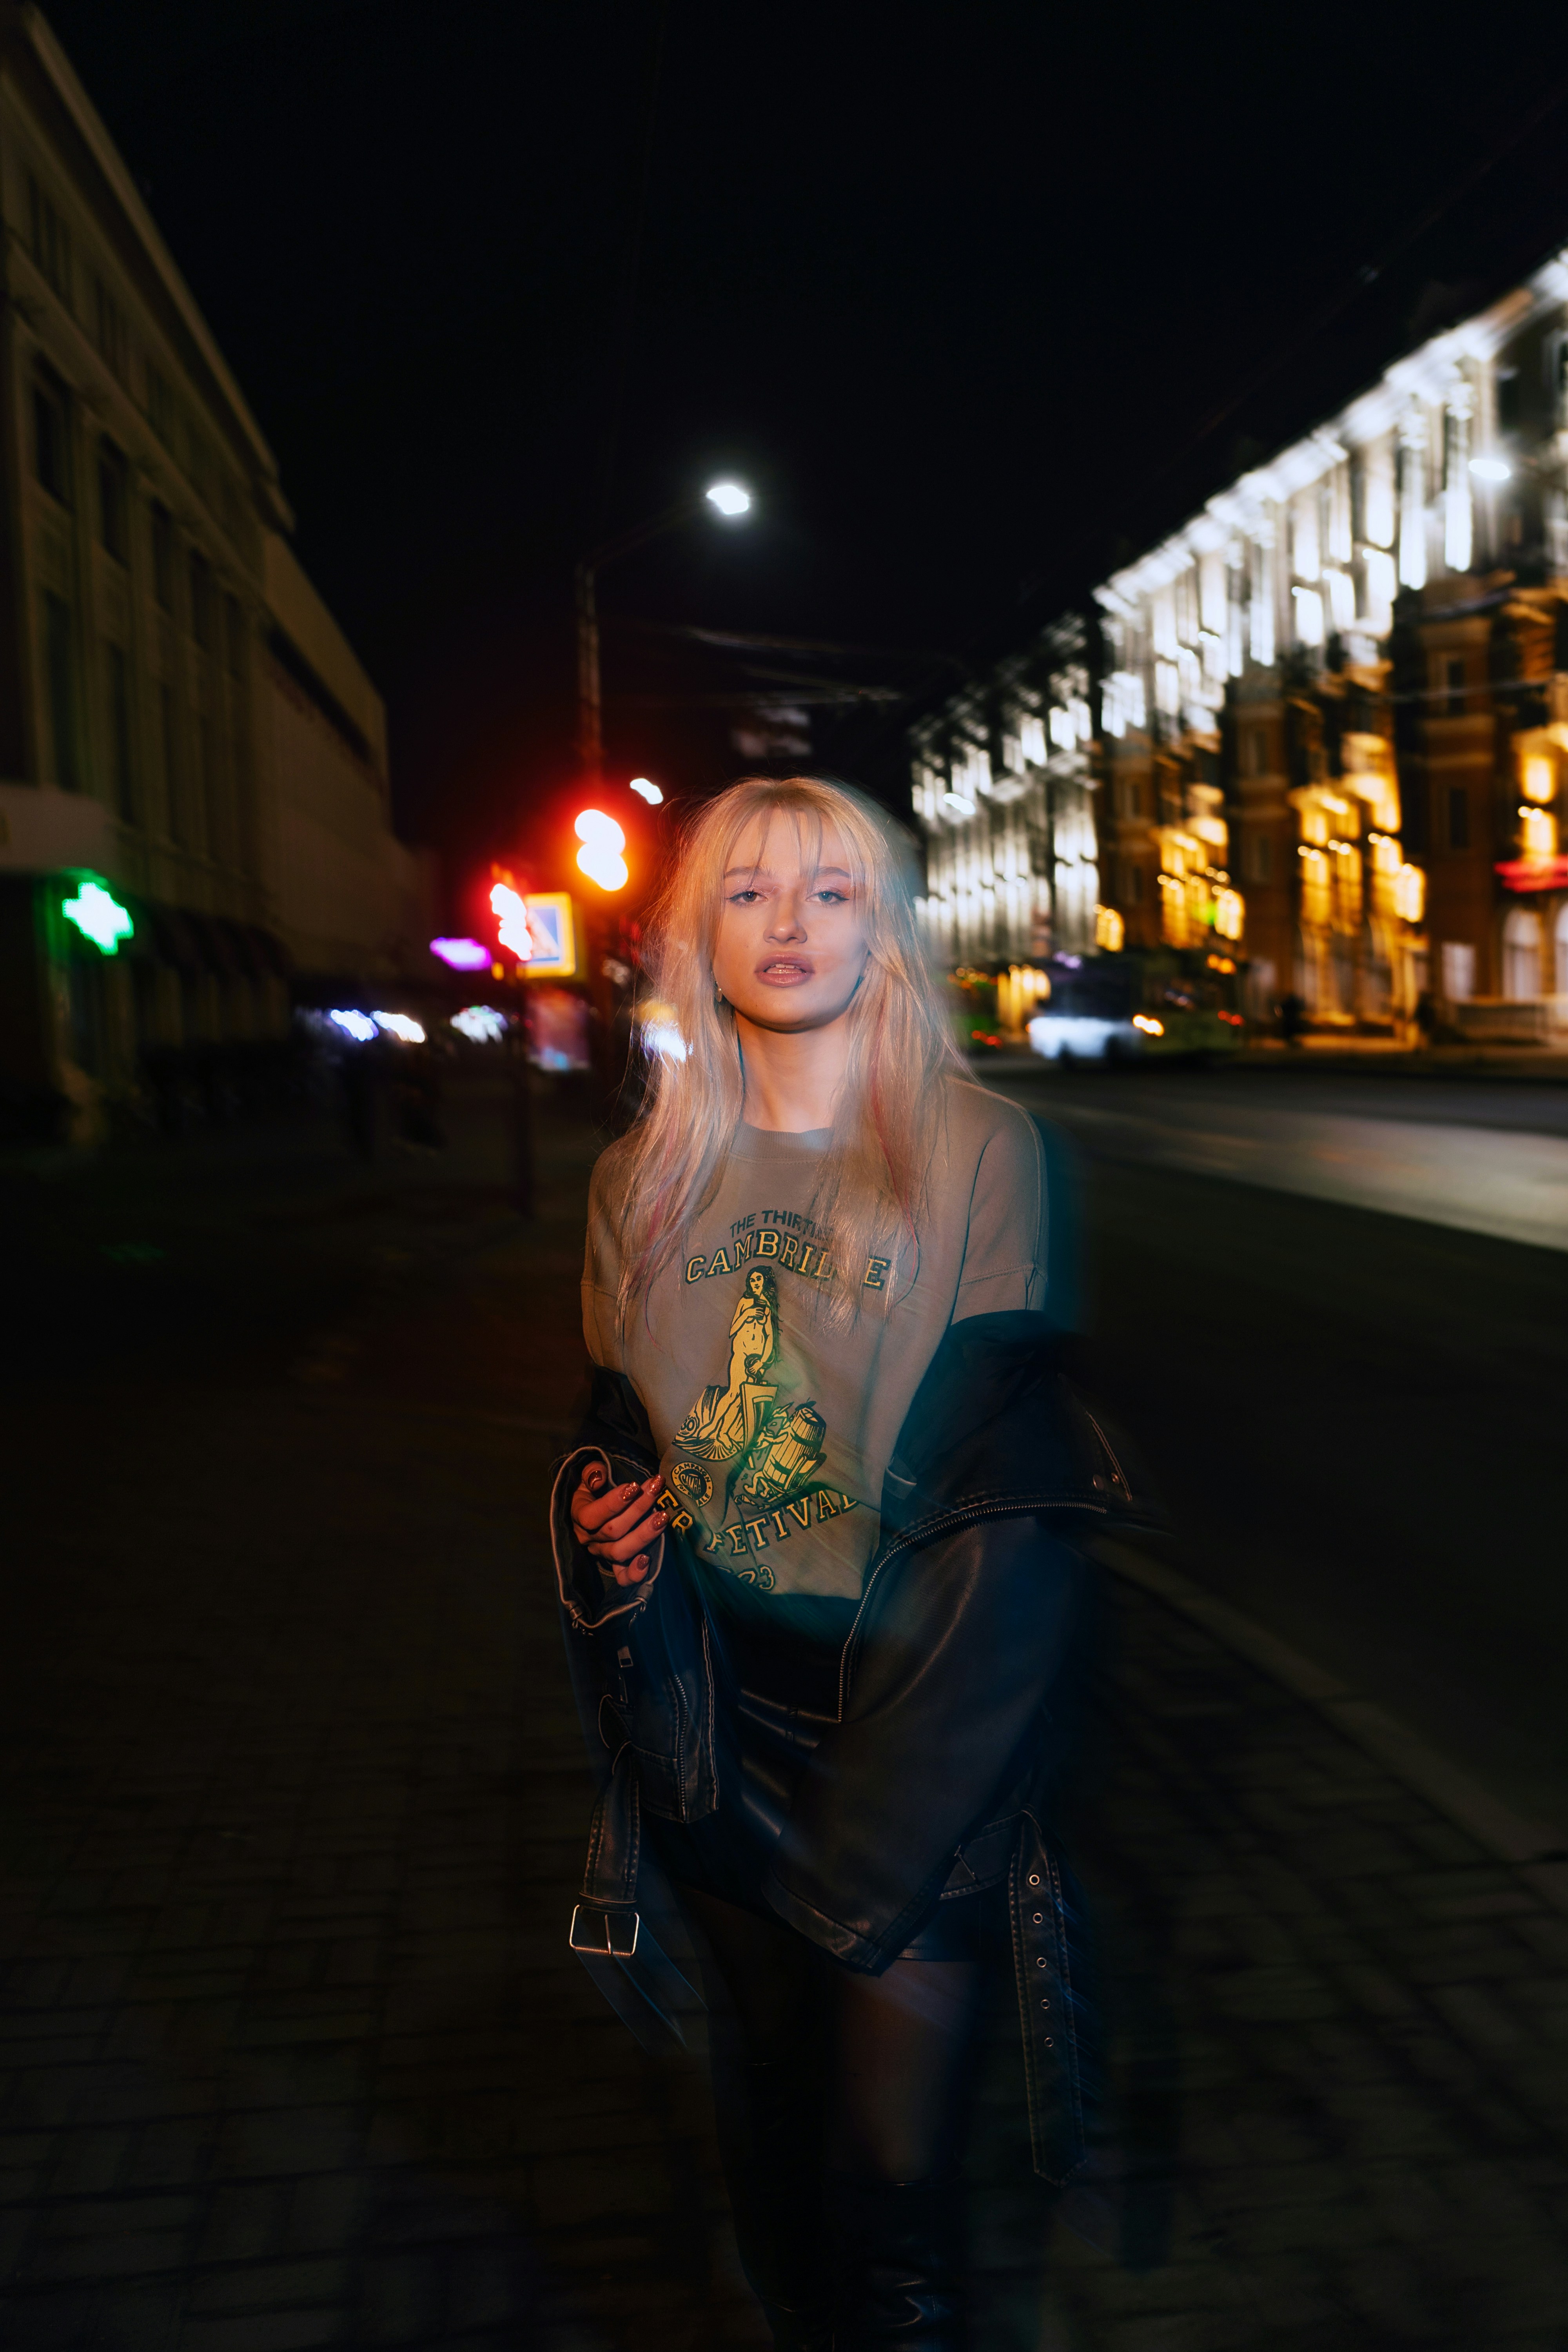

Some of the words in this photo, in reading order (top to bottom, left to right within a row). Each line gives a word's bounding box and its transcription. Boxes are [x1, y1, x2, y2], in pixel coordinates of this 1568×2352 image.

[730, 1213, 756, 1238] THE
[685, 1229, 891, 1291] CAMBRIDE
[673, 1463, 711, 1483] CAMPAIGN
[698, 1493, 710, 1506] ALE
[656, 1486, 695, 1537] ER
[703, 1489, 859, 1556] FETIVAL
